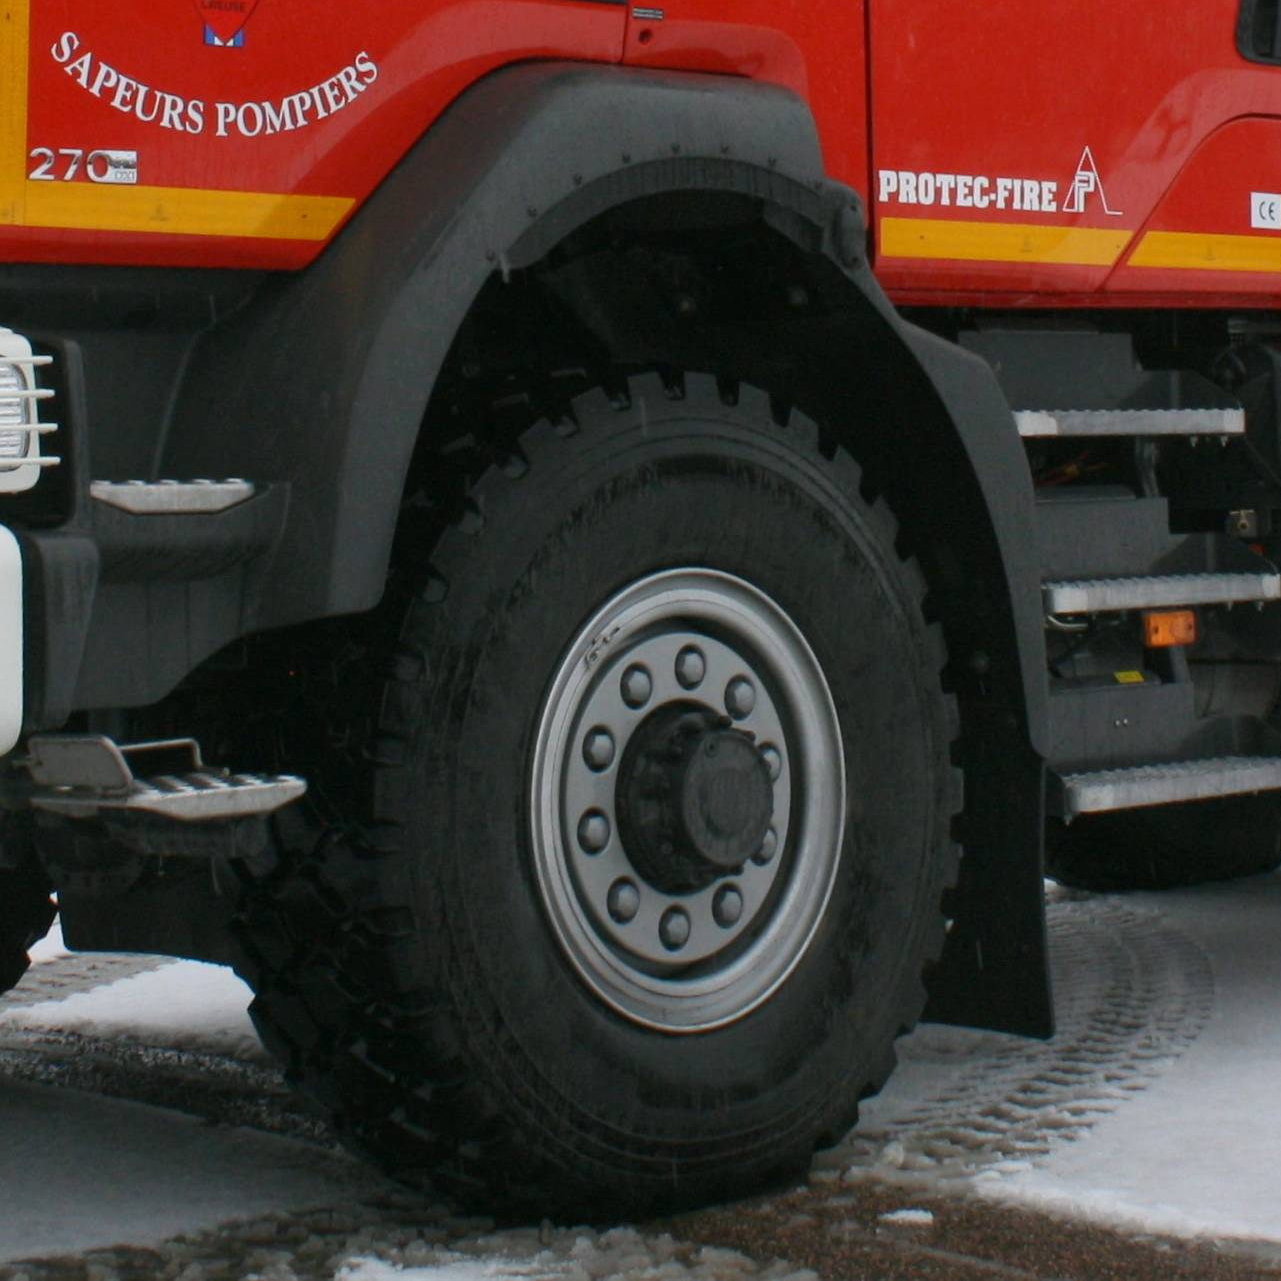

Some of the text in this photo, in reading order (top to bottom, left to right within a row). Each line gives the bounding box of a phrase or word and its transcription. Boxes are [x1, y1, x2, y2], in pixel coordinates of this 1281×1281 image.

[50, 31, 379, 137] SAPEURS POMPIERS
[29, 147, 111, 184] 270
[878, 169, 1058, 213] PROTEC-FIRE
